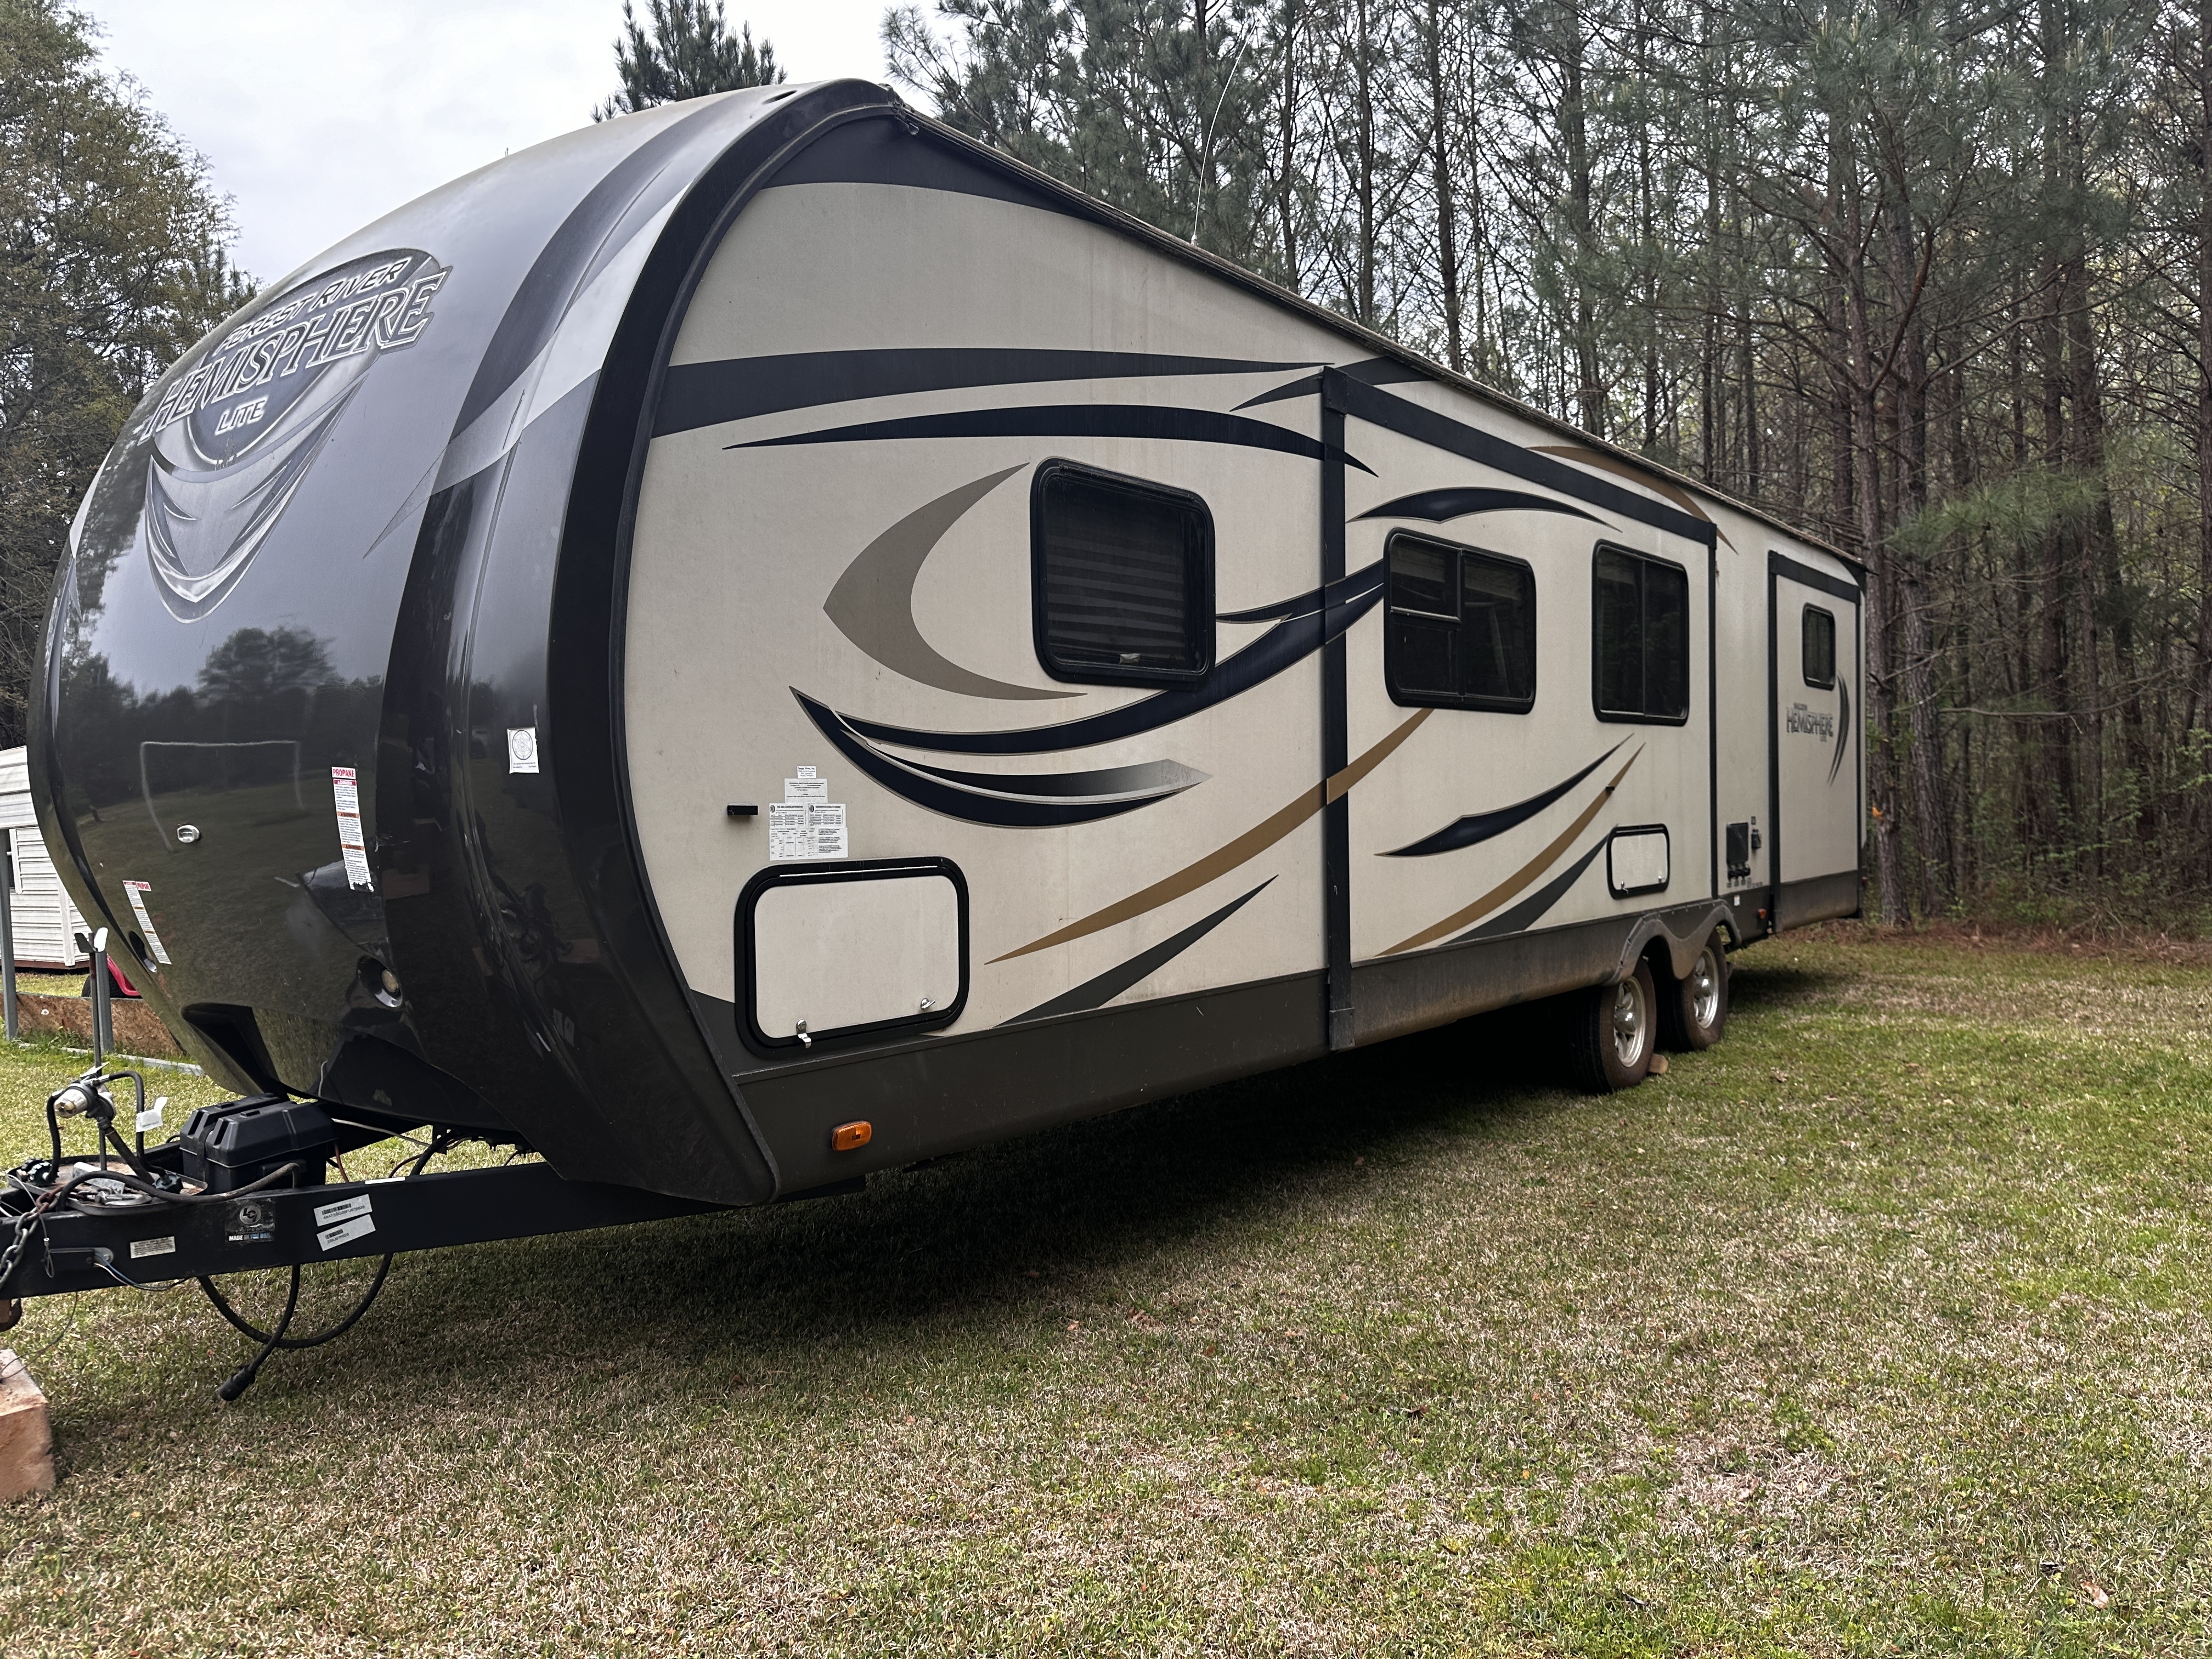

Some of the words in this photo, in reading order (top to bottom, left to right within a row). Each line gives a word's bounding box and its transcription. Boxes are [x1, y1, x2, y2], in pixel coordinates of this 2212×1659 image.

[308, 256, 413, 312] RIVER
[138, 269, 449, 446] HEMISPHERE
[215, 395, 269, 436] LITE
[332, 769, 355, 777] PROPANE
